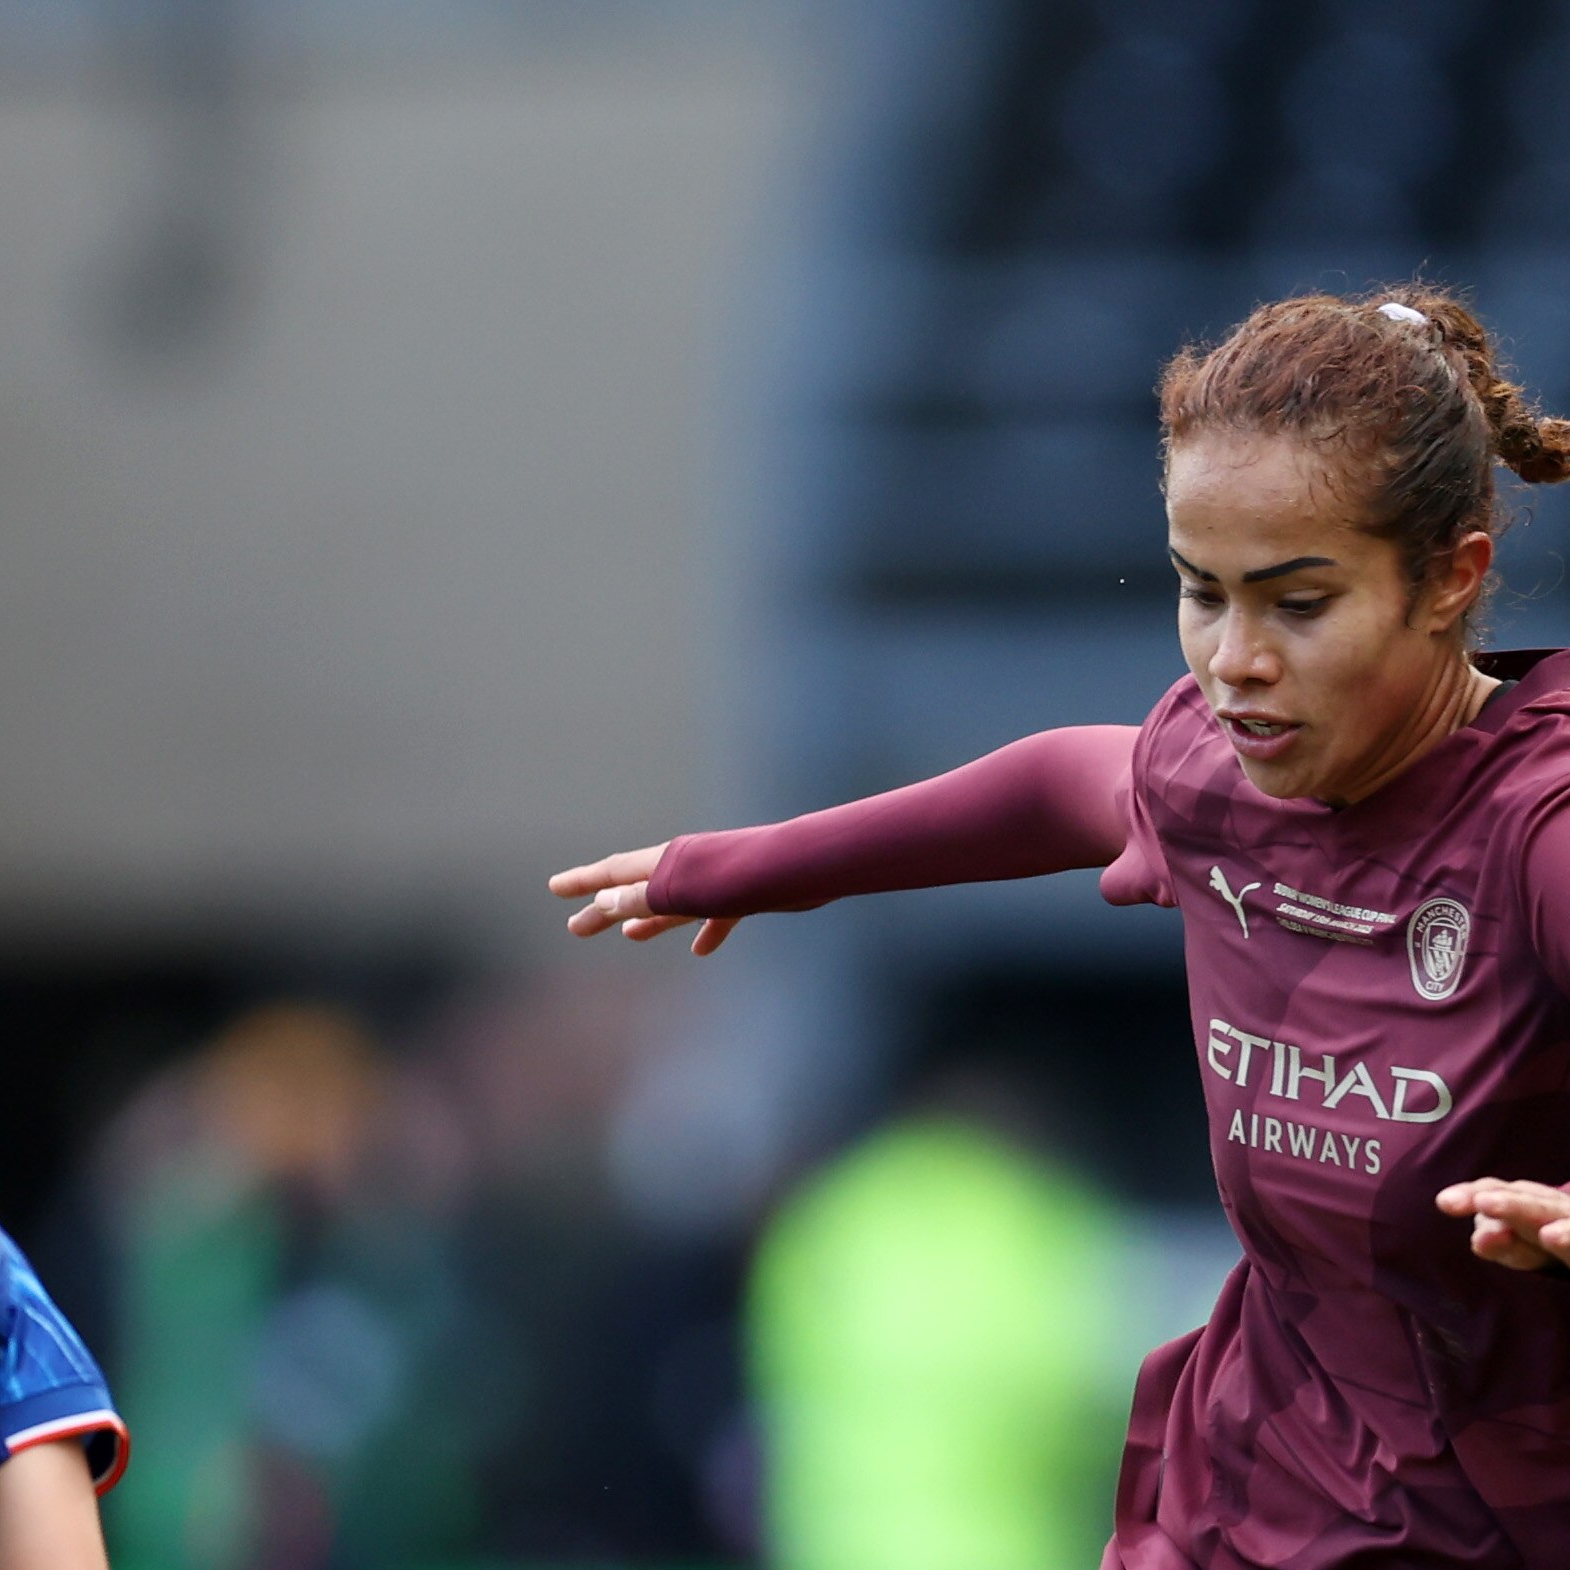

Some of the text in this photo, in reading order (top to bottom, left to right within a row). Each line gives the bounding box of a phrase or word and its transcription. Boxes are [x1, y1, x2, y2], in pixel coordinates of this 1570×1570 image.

[1425, 980, 1445, 993] CITY
[1207, 1018, 1453, 1123] ETIHAD
[1228, 1109, 1382, 1175] AIRWAYS
